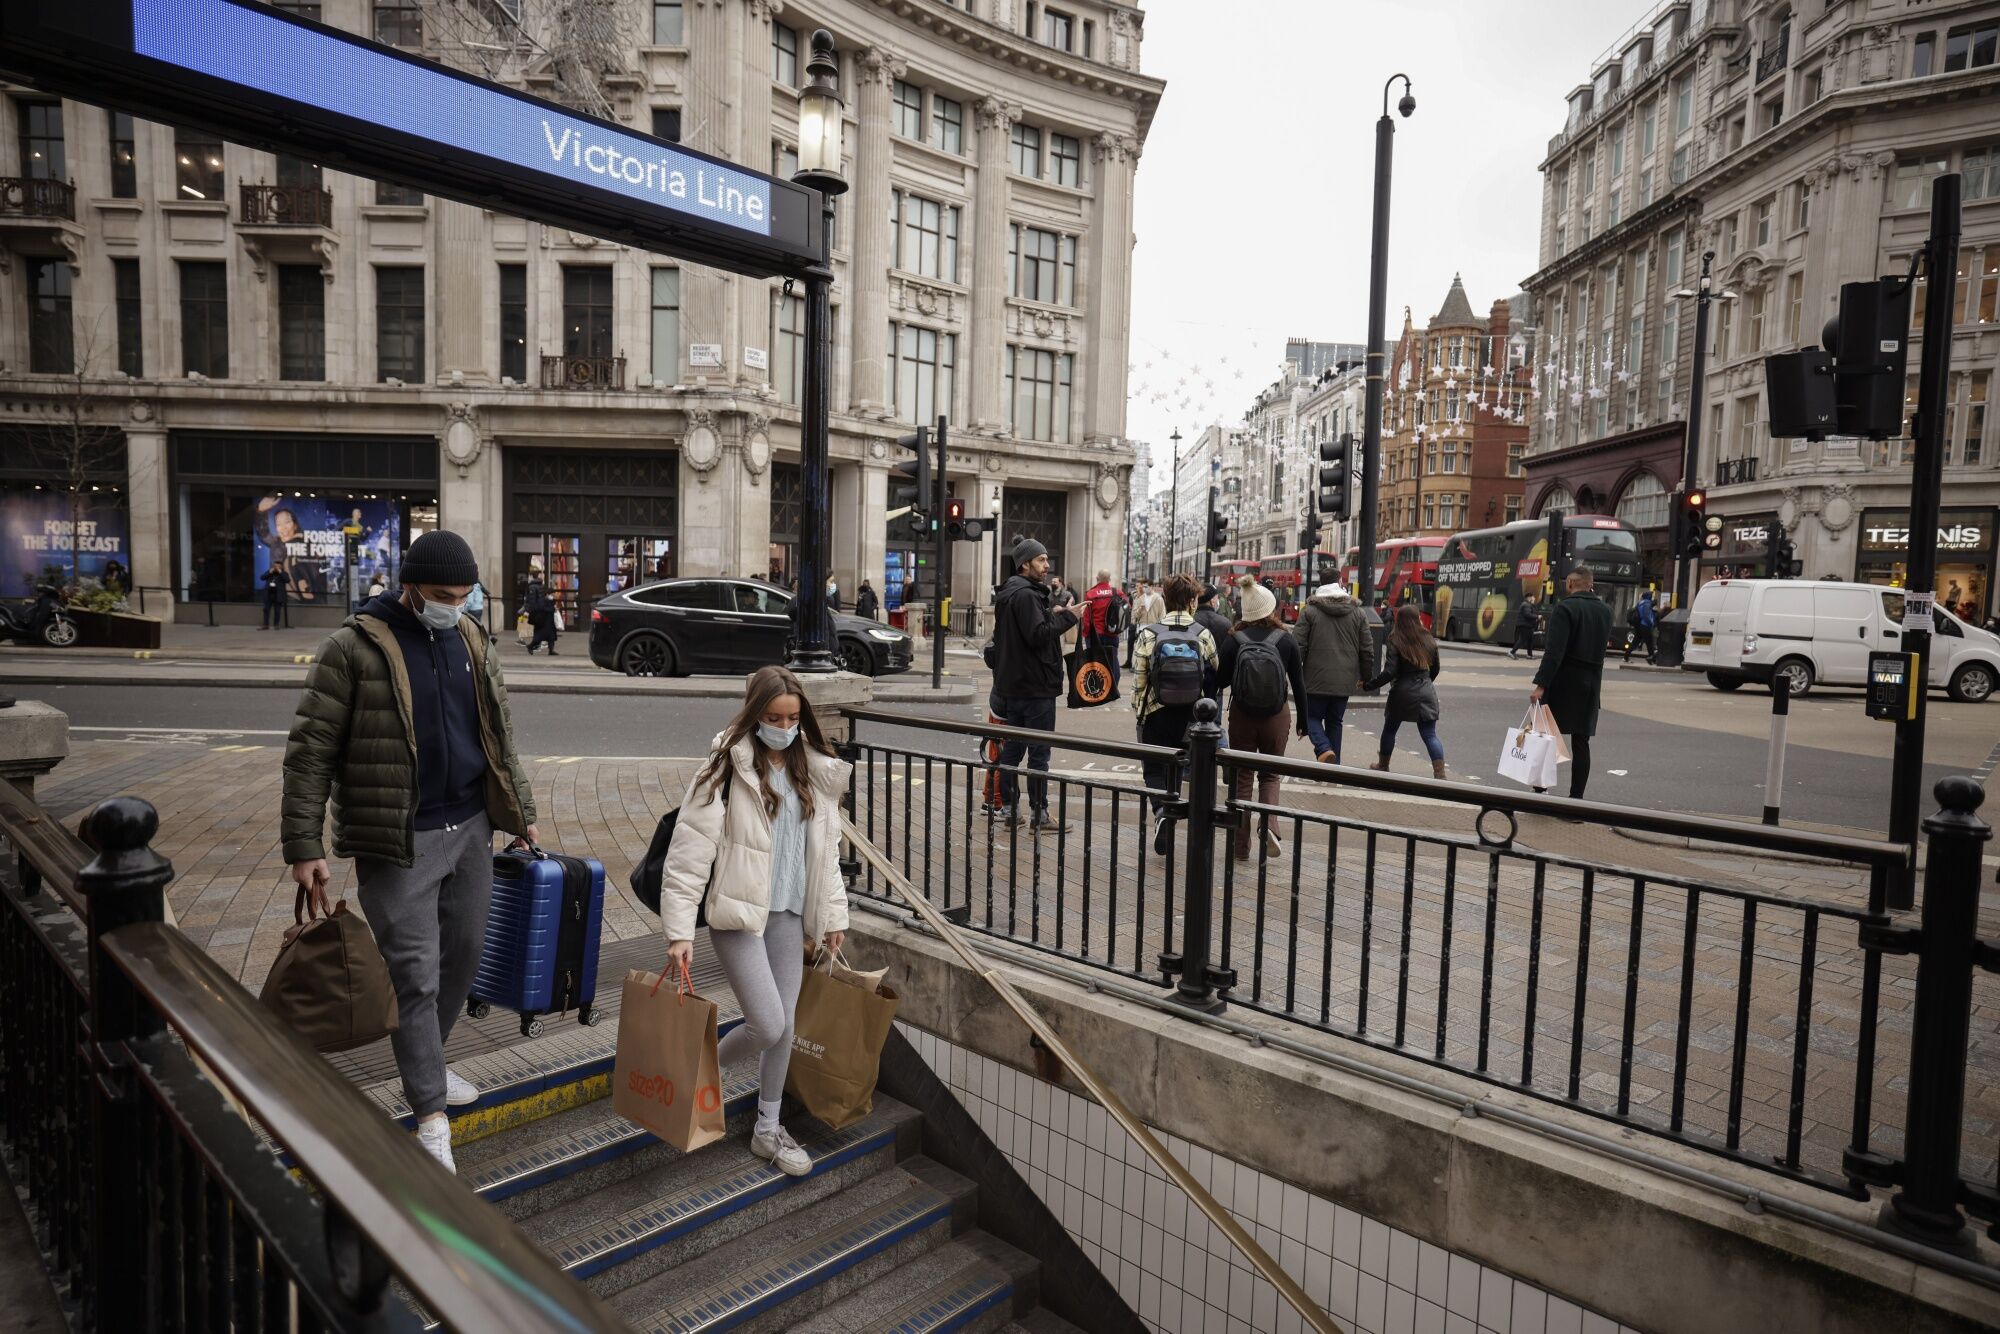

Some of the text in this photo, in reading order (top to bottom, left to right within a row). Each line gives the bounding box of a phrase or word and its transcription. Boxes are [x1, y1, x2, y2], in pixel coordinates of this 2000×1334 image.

[542, 120, 764, 221] Victoria Line
[22, 535, 48, 550] THE
[285, 542, 368, 557] THE FORECT
[1439, 561, 1492, 573] WHEN YOU HOPPED
[1617, 563, 1630, 574] 73
[1438, 573, 1448, 582] OFF
[1449, 573, 1459, 582] THE
[1459, 572, 1471, 582] BUS
[1875, 672, 1902, 684] WAIT
[797, 1037, 812, 1049] NIKE
[812, 1043, 825, 1053] APP
